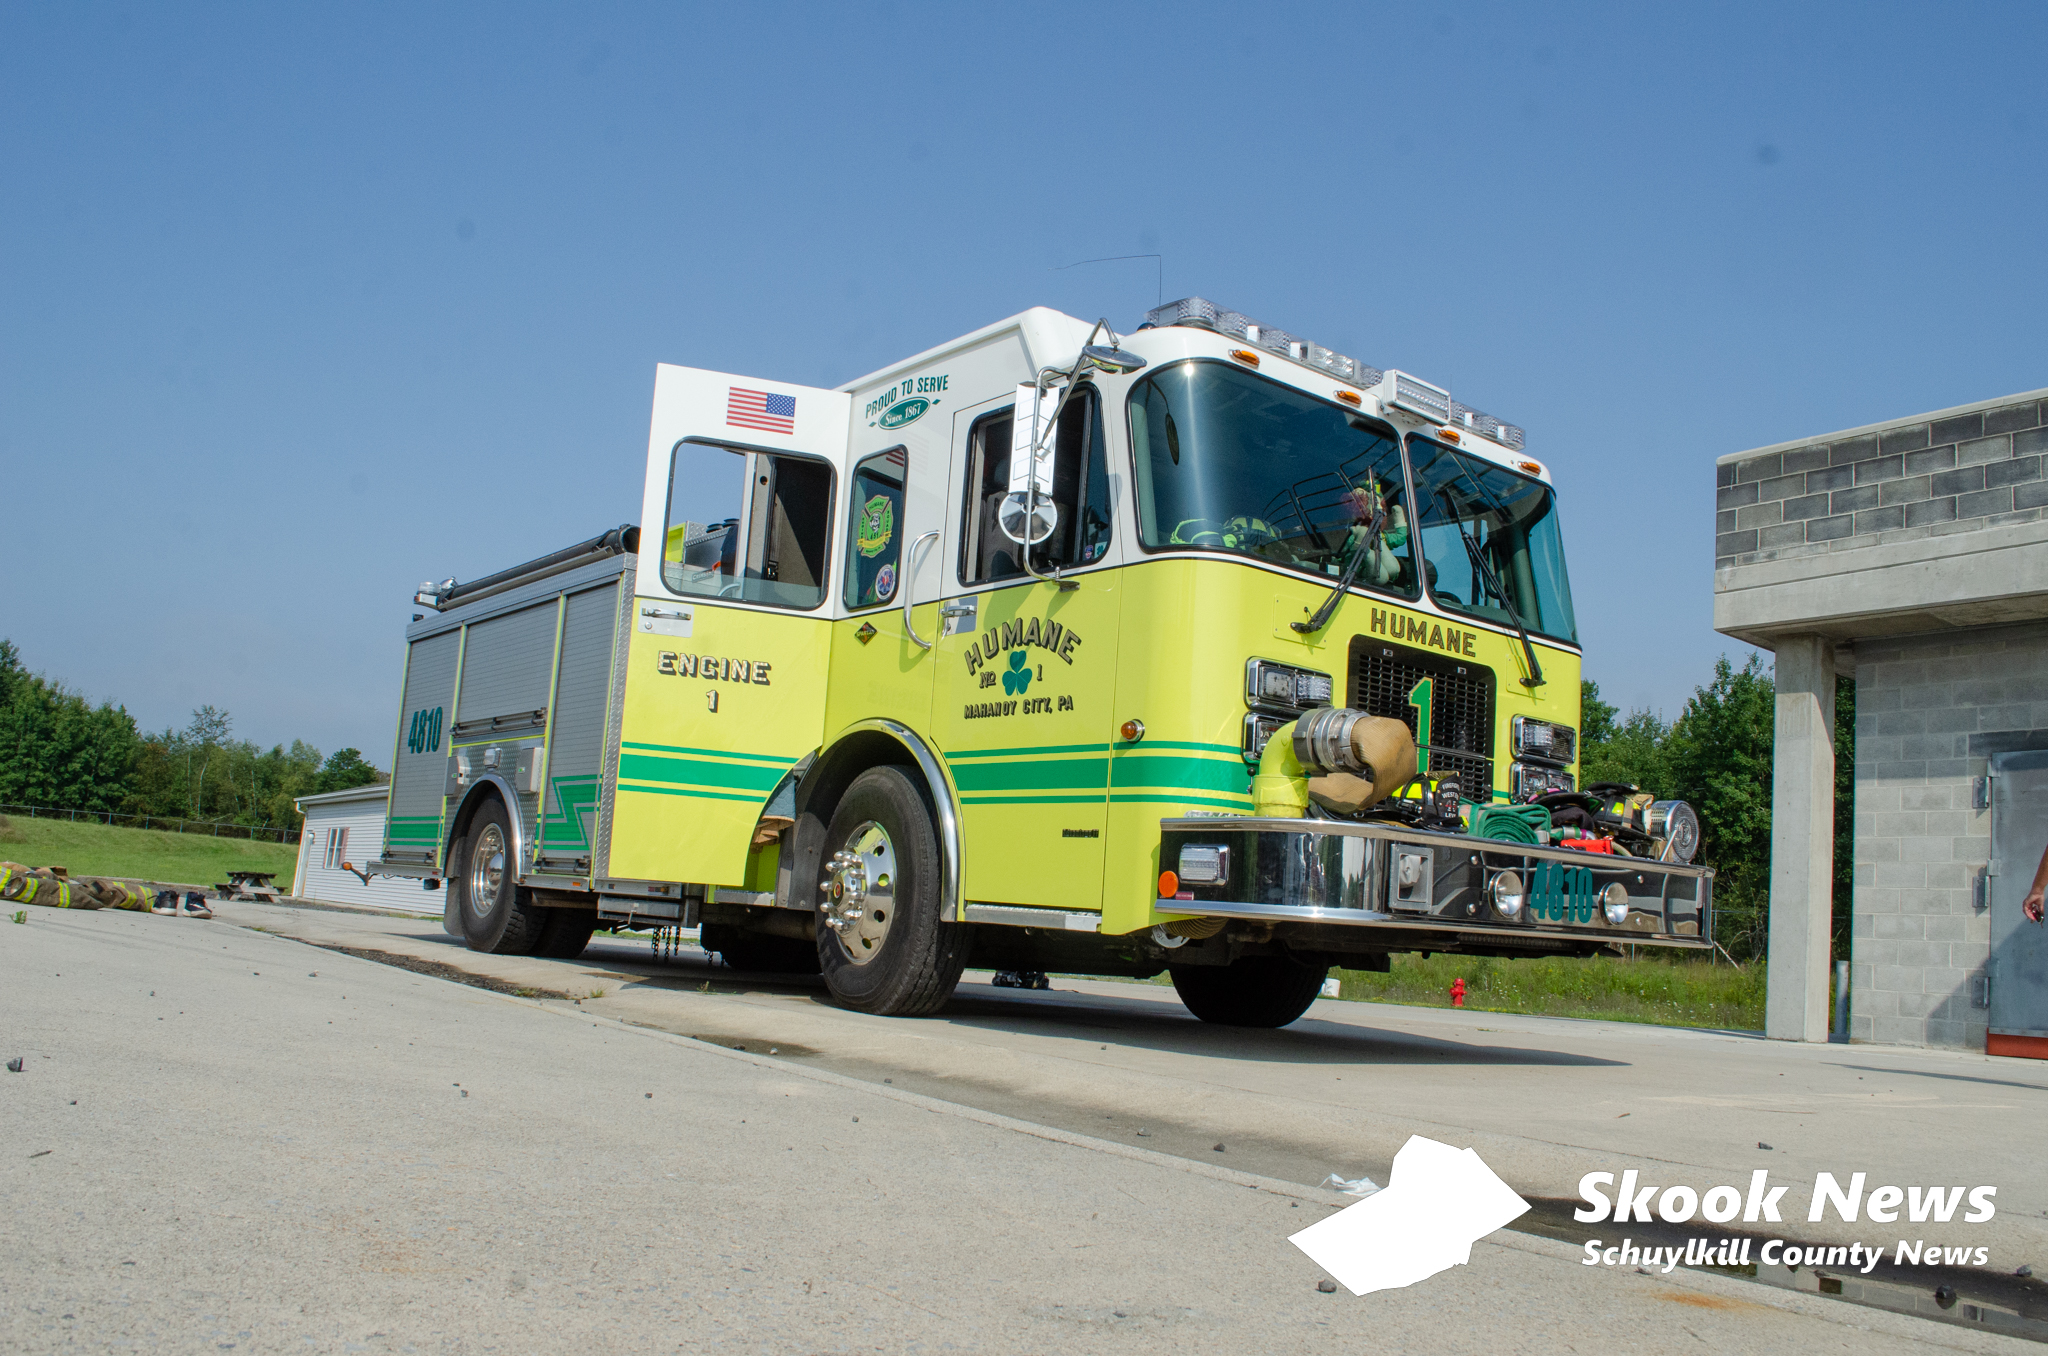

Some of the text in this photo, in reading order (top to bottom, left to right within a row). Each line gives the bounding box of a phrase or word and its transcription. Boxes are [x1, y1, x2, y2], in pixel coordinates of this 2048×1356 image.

[866, 374, 949, 419] PROUD TO SERVE
[885, 403, 921, 425] Since 1867
[964, 617, 1082, 676] HUMANE
[1371, 607, 1476, 658] HUMANE
[657, 650, 772, 686] ENGINE
[706, 689, 719, 713] 1
[964, 695, 1074, 719] MAHANOY CITY, PA
[408, 706, 443, 754] 4810
[1409, 676, 1433, 775] 1
[1530, 862, 1593, 924] 4810
